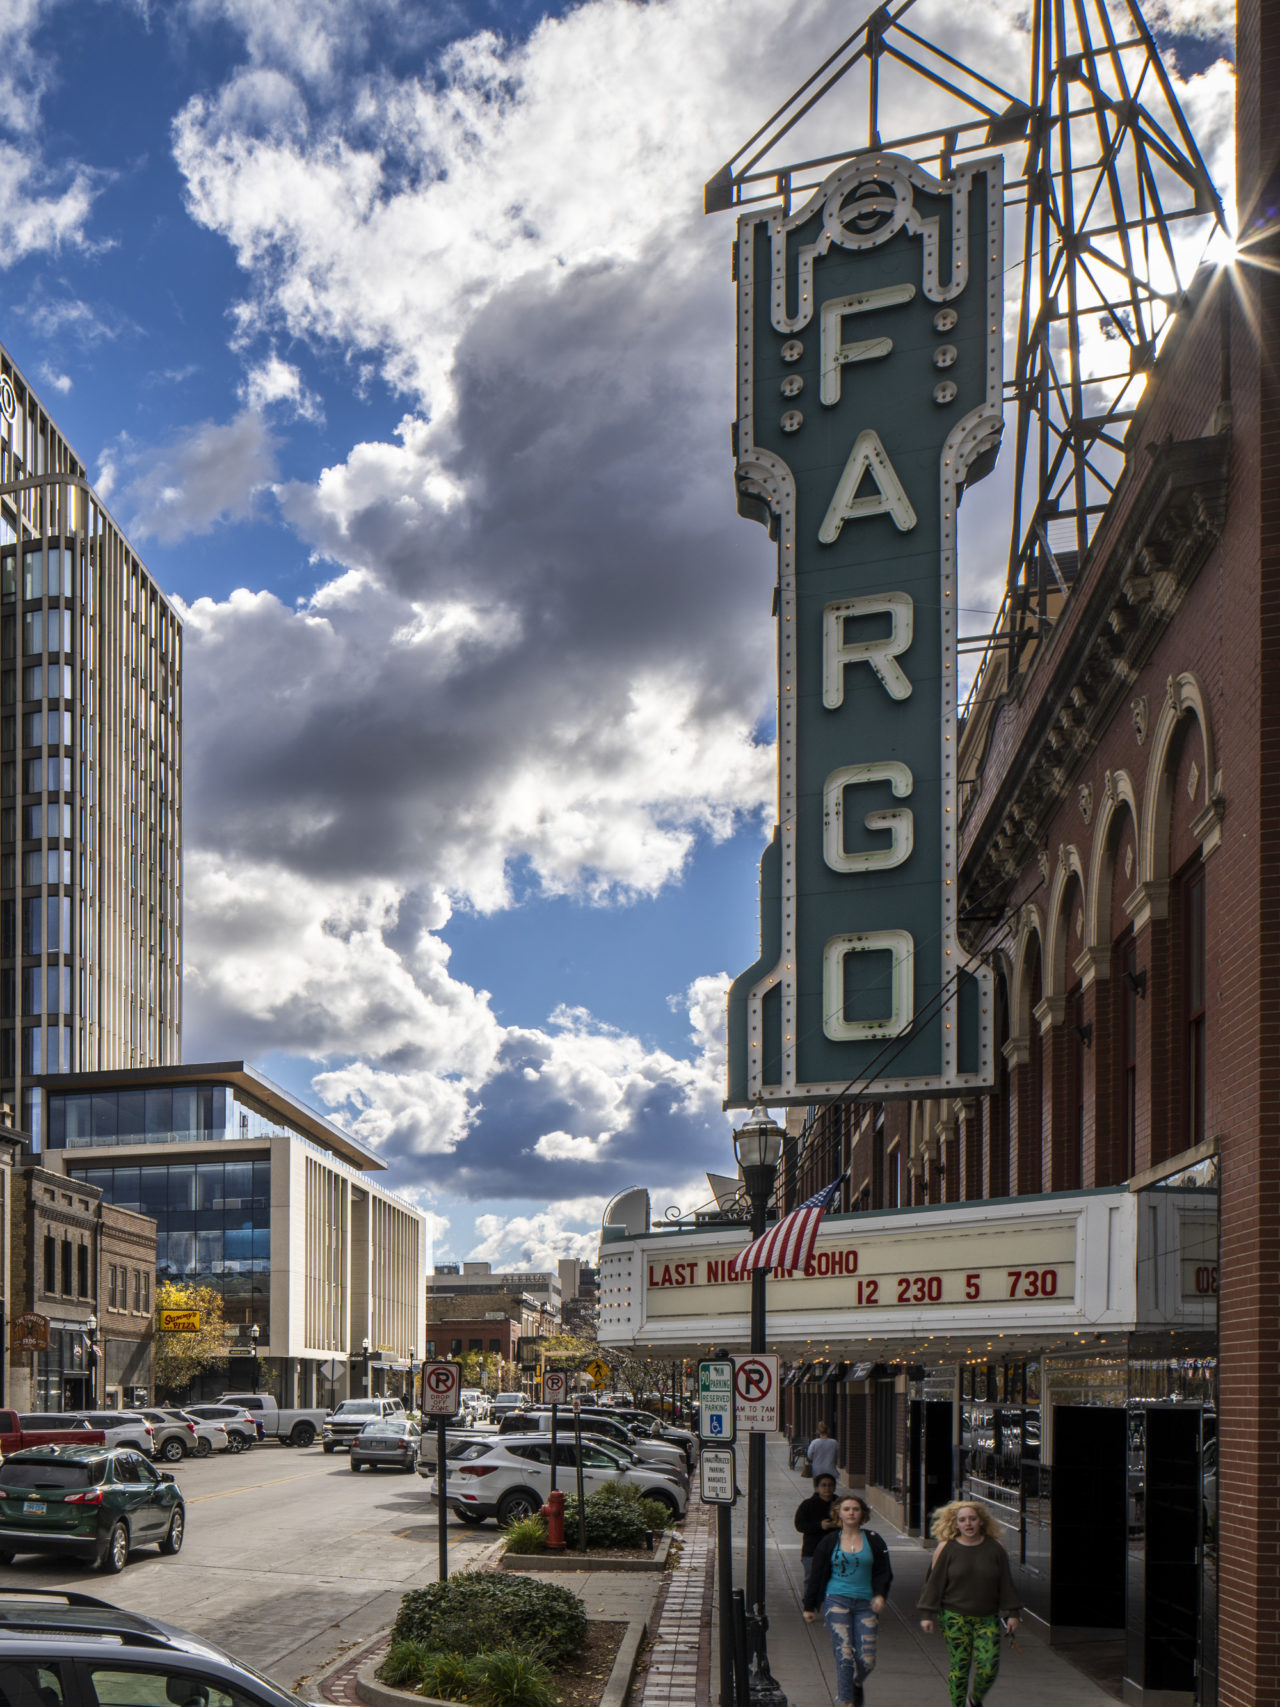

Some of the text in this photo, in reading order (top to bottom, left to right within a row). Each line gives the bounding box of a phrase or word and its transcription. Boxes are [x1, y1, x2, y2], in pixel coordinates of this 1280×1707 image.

[817, 281, 917, 1043] FARGO
[649, 1262, 698, 1287] LAST
[707, 1260, 752, 1283] NIGH
[804, 1250, 858, 1278] SOHO
[857, 1269, 1058, 1305] 12 230 5 730
[701, 1371, 710, 1385] 90
[710, 1379, 730, 1389] PARKING
[703, 1394, 730, 1403] RESERVED
[704, 1404, 728, 1412] PARKING
[761, 1405, 775, 1413] 7AM
